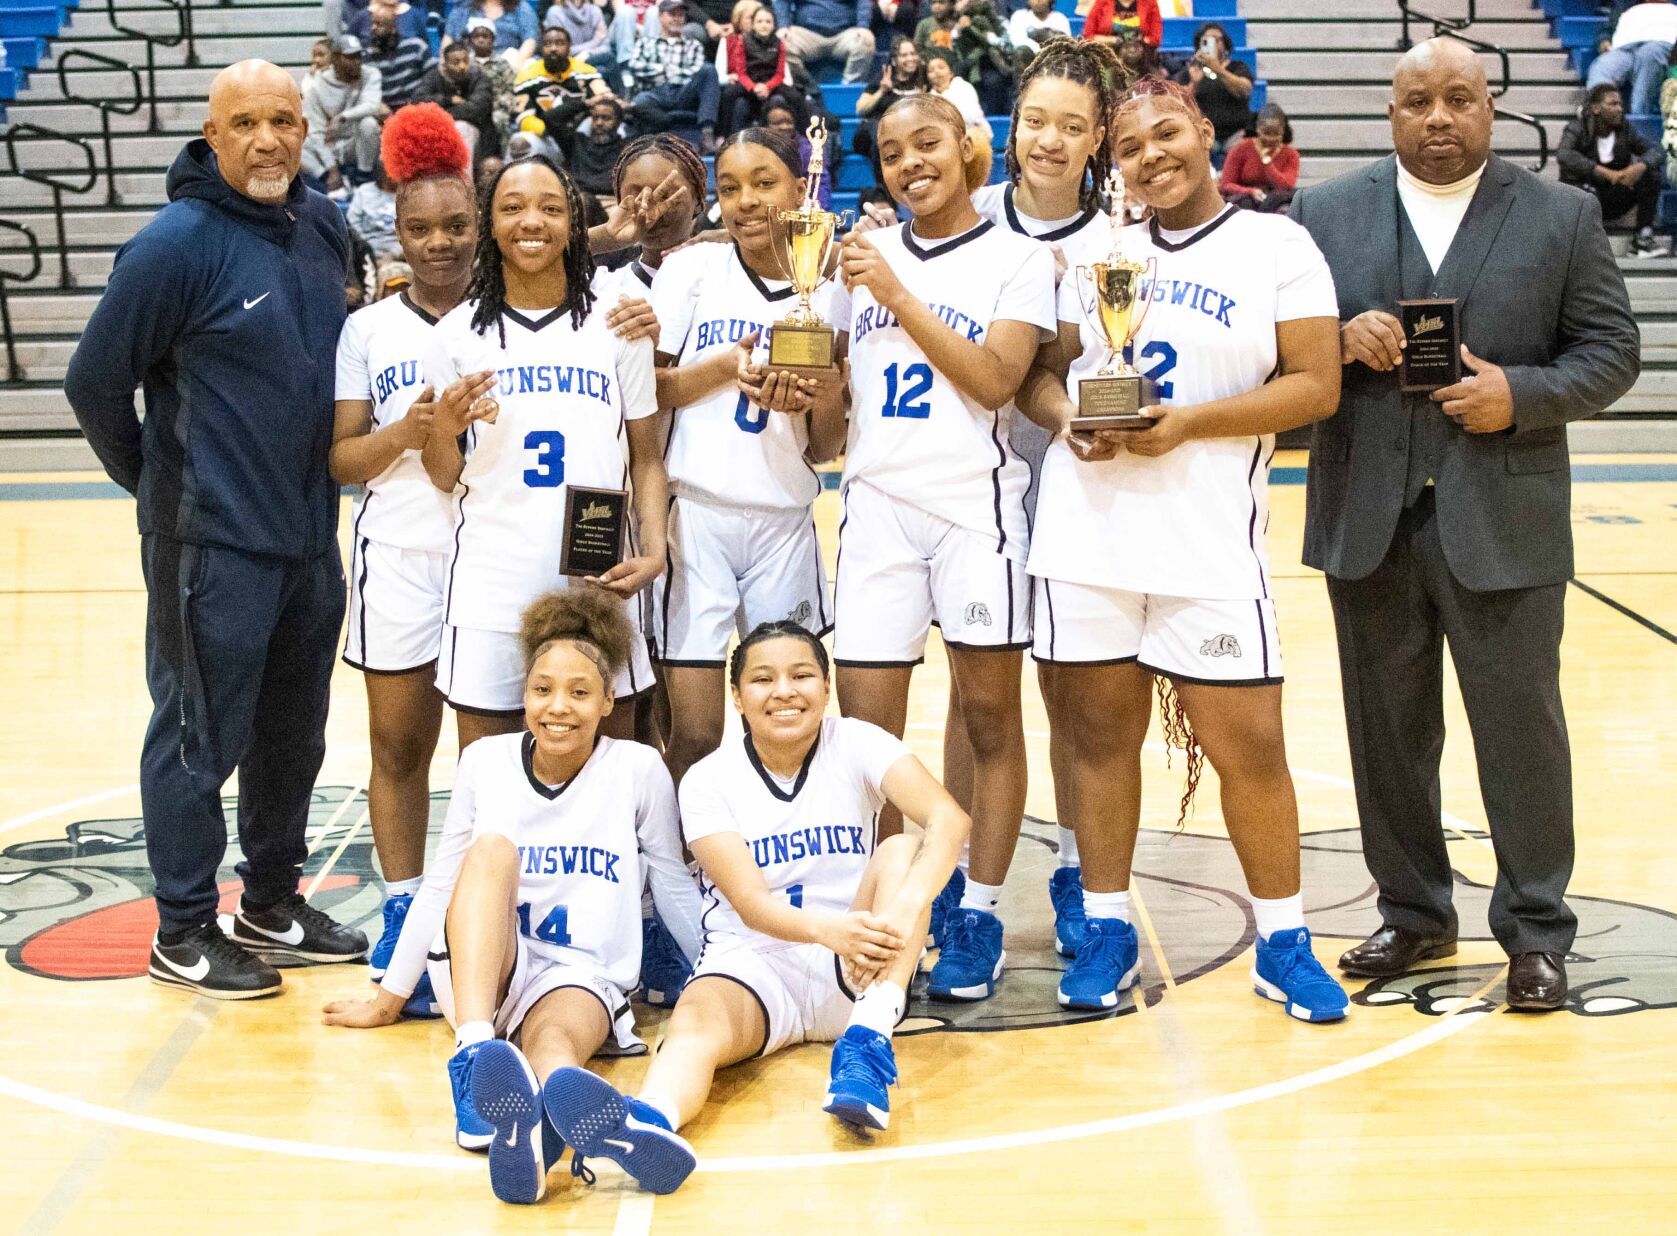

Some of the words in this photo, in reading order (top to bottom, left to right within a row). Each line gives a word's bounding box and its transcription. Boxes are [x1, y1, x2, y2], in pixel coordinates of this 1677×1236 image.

[497, 365, 611, 405] UNSWICK
[881, 362, 934, 419] 12
[523, 431, 565, 488] 3
[752, 825, 866, 868] UNSWICK
[516, 902, 572, 946] 14
